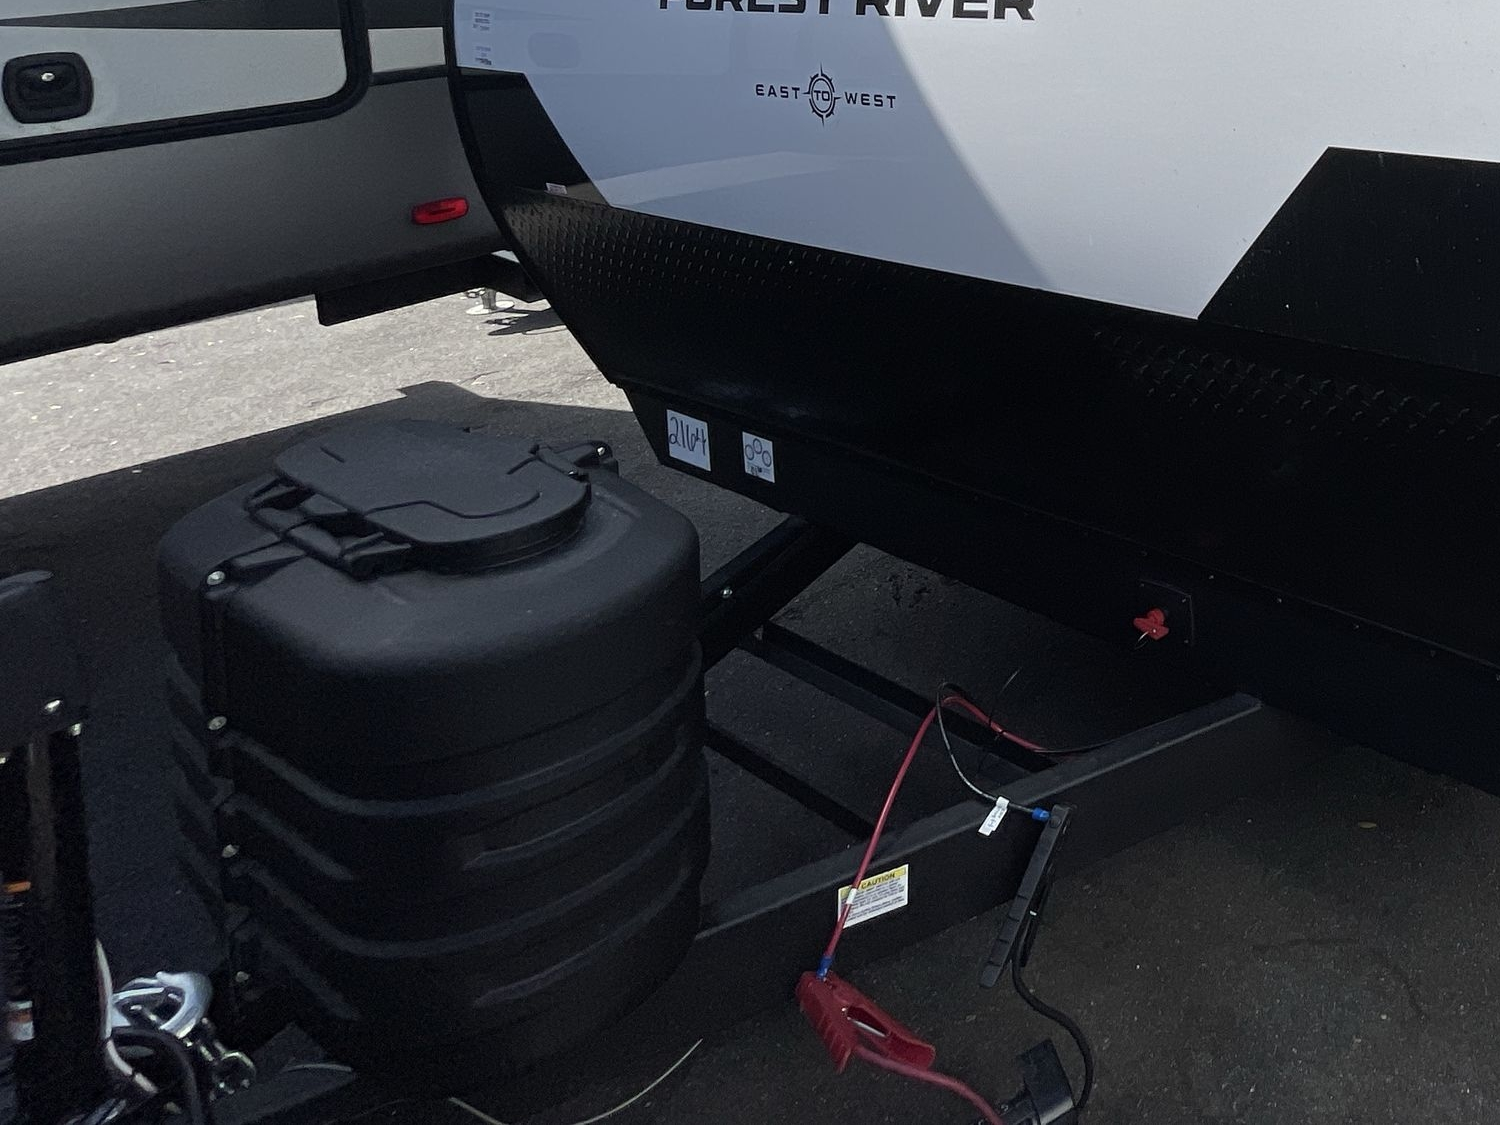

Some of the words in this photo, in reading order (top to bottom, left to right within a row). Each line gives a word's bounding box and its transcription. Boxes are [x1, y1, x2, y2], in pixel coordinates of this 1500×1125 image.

[755, 84, 800, 100] EAST
[814, 90, 830, 102] TO
[844, 92, 896, 108] WEST
[669, 416, 707, 456] 2164
[861, 872, 896, 890] CAUTION
